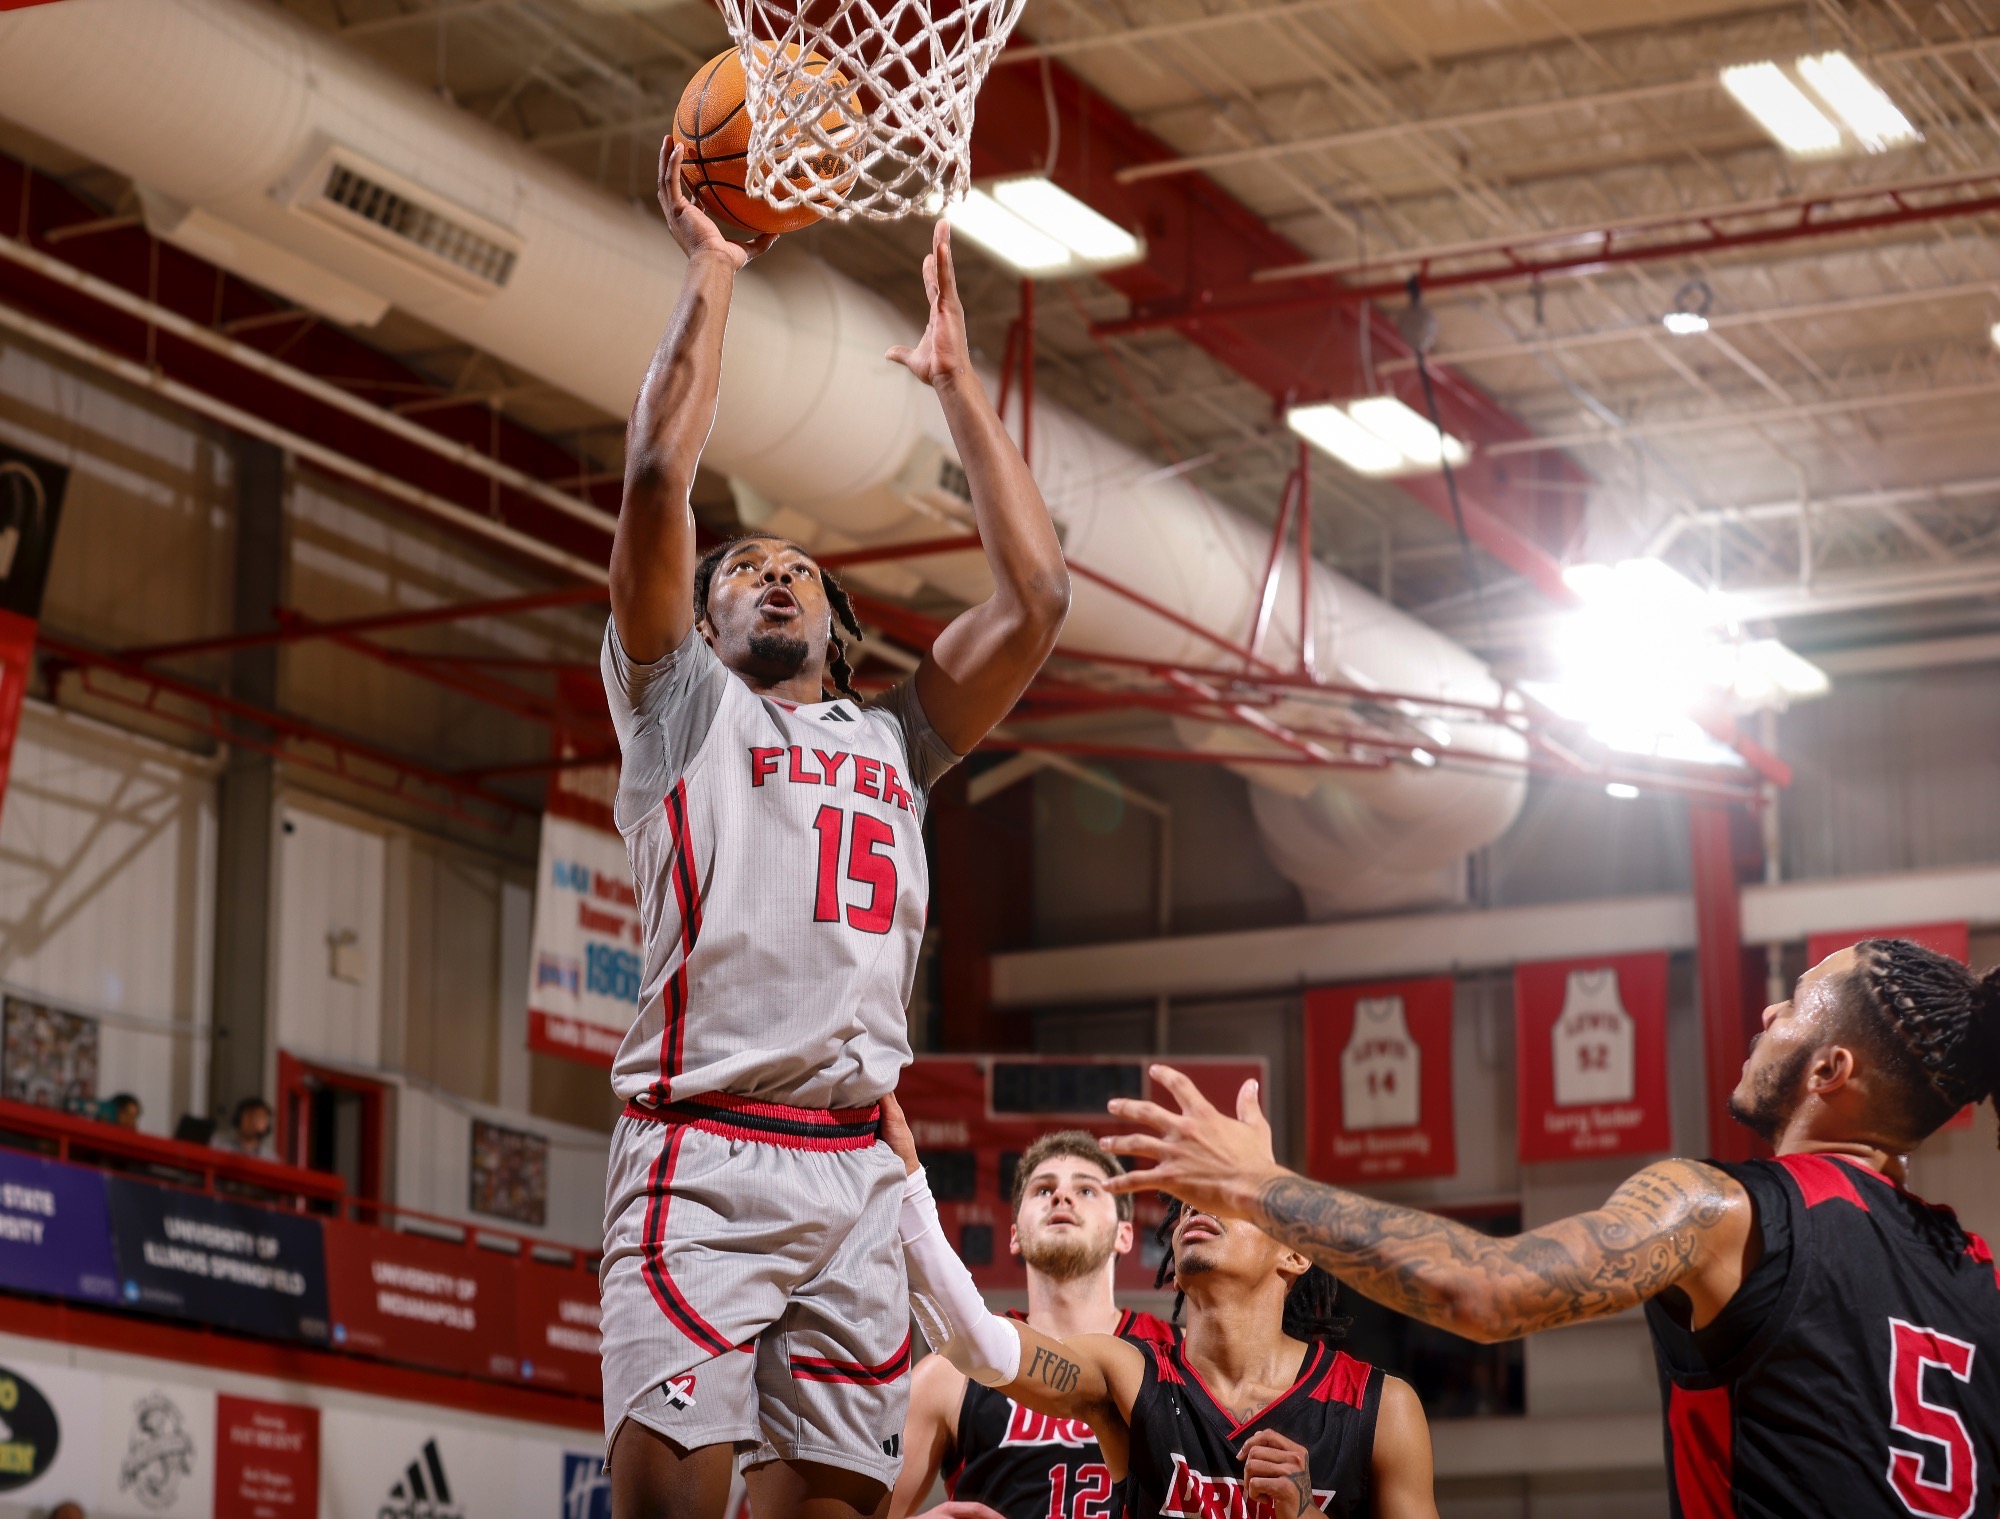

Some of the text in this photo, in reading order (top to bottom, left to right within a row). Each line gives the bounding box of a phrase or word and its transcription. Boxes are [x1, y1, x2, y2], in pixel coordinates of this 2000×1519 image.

[748, 745, 919, 821] FLYER
[812, 804, 898, 935] 15
[1027, 1346, 1081, 1398] FEAR
[1886, 1316, 1978, 1519] 5
[1045, 1463, 1113, 1519] 12
